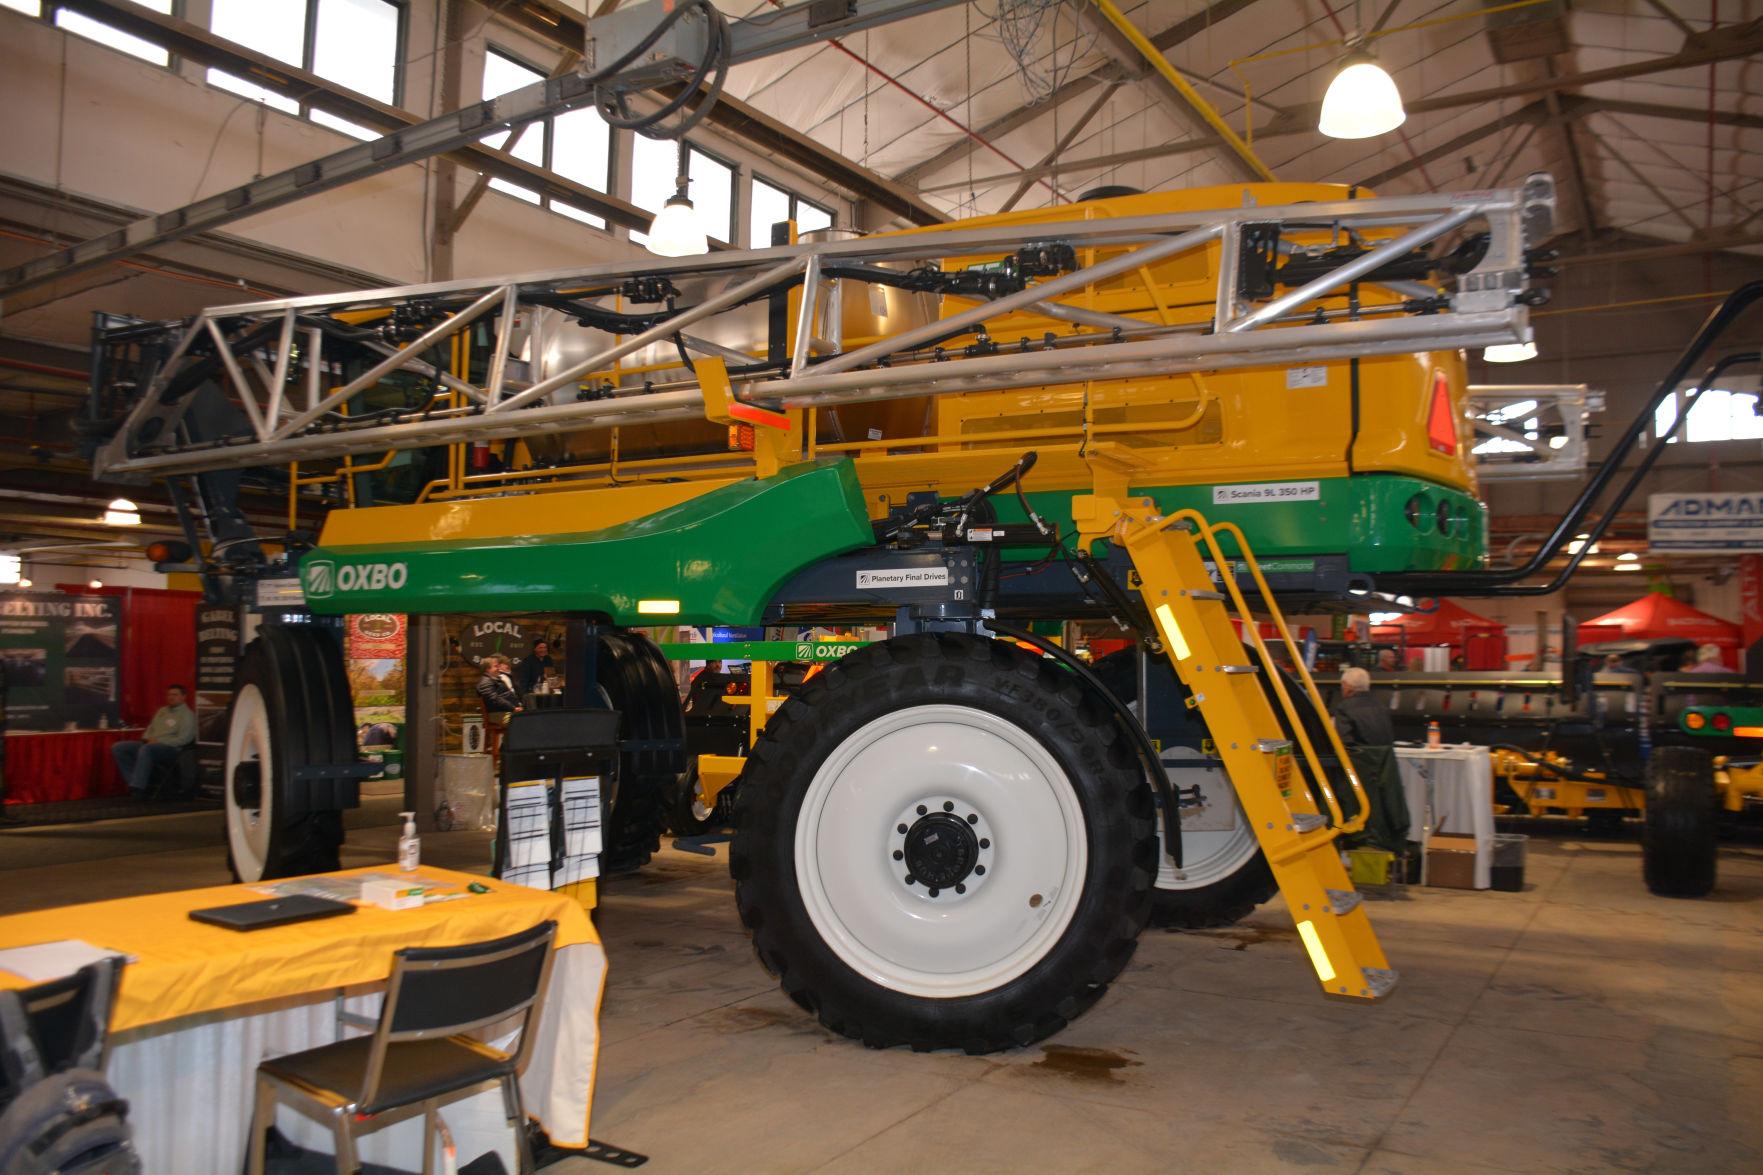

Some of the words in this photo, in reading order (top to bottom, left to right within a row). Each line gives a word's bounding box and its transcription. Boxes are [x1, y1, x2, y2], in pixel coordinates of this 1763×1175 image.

[1230, 488, 1261, 499] Scania
[1264, 488, 1275, 497] 9L
[1279, 487, 1297, 496] 350
[1300, 486, 1315, 495] HP
[1659, 498, 1763, 516] ADMA
[337, 562, 407, 591] OXBO
[871, 574, 903, 583] Planetary
[905, 573, 922, 581] Final
[924, 573, 946, 581] Drives
[74, 603, 113, 617] INC.
[472, 621, 522, 639] LOCAL
